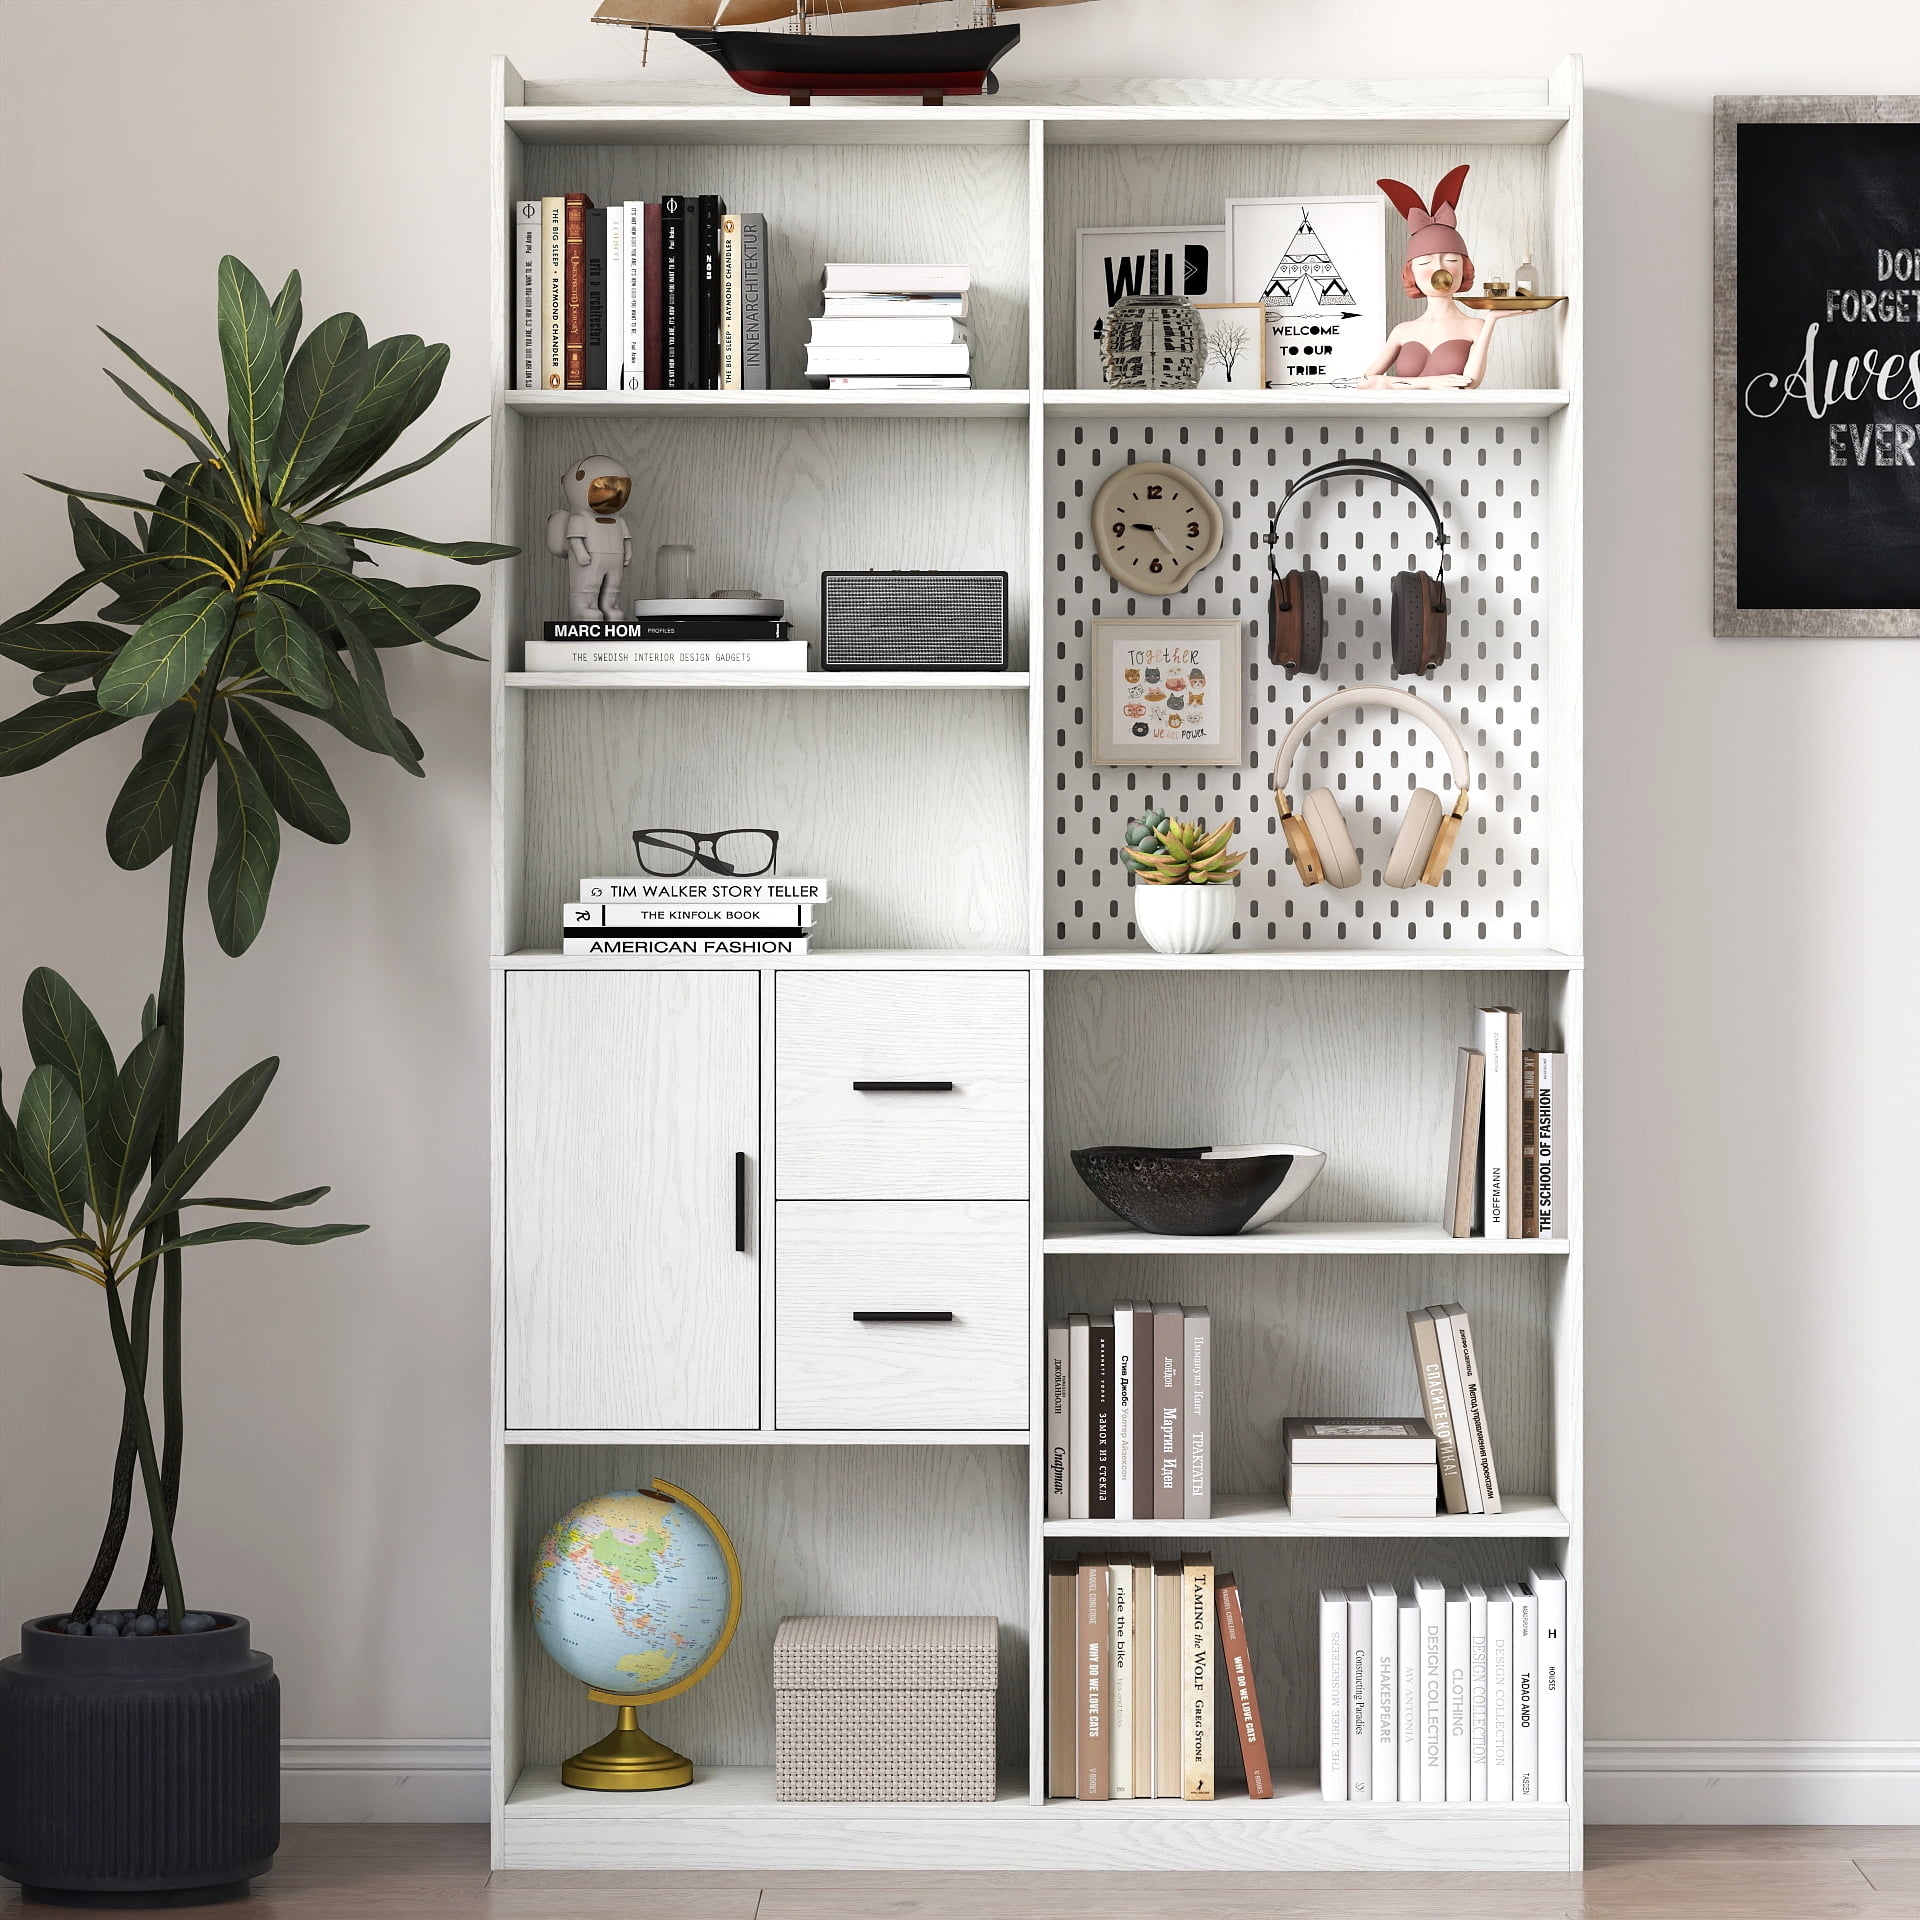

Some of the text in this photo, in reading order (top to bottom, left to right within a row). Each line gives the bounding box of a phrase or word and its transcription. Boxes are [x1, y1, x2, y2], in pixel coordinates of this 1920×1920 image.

[551, 208, 560, 267] THE BIG SLEEP
[724, 239, 733, 321] RAYMOND CHANDLER
[743, 224, 761, 368] INNENARCHITEKTUR
[551, 278, 560, 368] RAYMOND CHANDLER
[589, 291, 603, 347] architecture
[1272, 325, 1340, 336] WELCOME
[724, 331, 733, 384] THE BIG SLEEP
[1280, 345, 1333, 356] TO OUR
[1286, 365, 1327, 376] TRIBE
[1829, 423, 1920, 467] EVER
[1147, 485, 1163, 501] 12
[1112, 522, 1126, 538] 9
[1186, 522, 1200, 538] 3
[1149, 558, 1163, 574] 6
[554, 624, 641, 638] MARC HOM
[572, 652, 751, 662] THE SWEDISH INTERIOR DESIGN GADGETS
[610, 885, 818, 898] TIM WALKER STORY TELLER
[641, 911, 760, 920] THE KINFOLK BOOK
[589, 941, 792, 953] AMERICAN FASHION
[1539, 1088, 1551, 1232] THE SCHOOL OF FASHION
[1492, 1167, 1501, 1223] HOFFMANN
[1119, 1355, 1129, 1406] Стив Джобс
[1193, 1391, 1204, 1416] Кант
[1099, 1413, 1107, 1445] замок
[1160, 1408, 1177, 1488] Мартин Иден
[1425, 1364, 1457, 1477] СПАСИТЕ КОТИКА!
[1467, 1383, 1479, 1408] Метод
[1480, 1458, 1495, 1499] проектами
[1051, 1447, 1066, 1495] Спартак
[1099, 1449, 1107, 1462] из
[1099, 1465, 1107, 1501] стекла
[1192, 1432, 1203, 1496] ТРАКТАТЫ
[1117, 1587, 1126, 1668] ride the bike
[1194, 1574, 1206, 1691] TAMING the WOLF
[1089, 1643, 1099, 1737] WHY DO WE LOVE CATS
[1233, 1656, 1256, 1743] WHY DO WE LOVE CATS
[1331, 1632, 1340, 1773] THE THREE MUSKETEERS
[1354, 1649, 1365, 1735] Constructing Paradies
[1379, 1656, 1391, 1744] SHAKESPEARE
[1405, 1666, 1414, 1743] MY ANTONIA
[1427, 1625, 1439, 1767] DESIGN COLLECTION
[1452, 1669, 1464, 1736] CLOTHING
[1472, 1636, 1486, 1764] DESIGN COLLECTION
[1495, 1639, 1505, 1766] DESIGN COLLECTION
[1521, 1673, 1530, 1728] TADAO ANDO
[1548, 1666, 1556, 1691] HOUSES
[1195, 1699, 1204, 1762] GREG STONE
[1089, 1773, 1097, 1794] BOOKS
